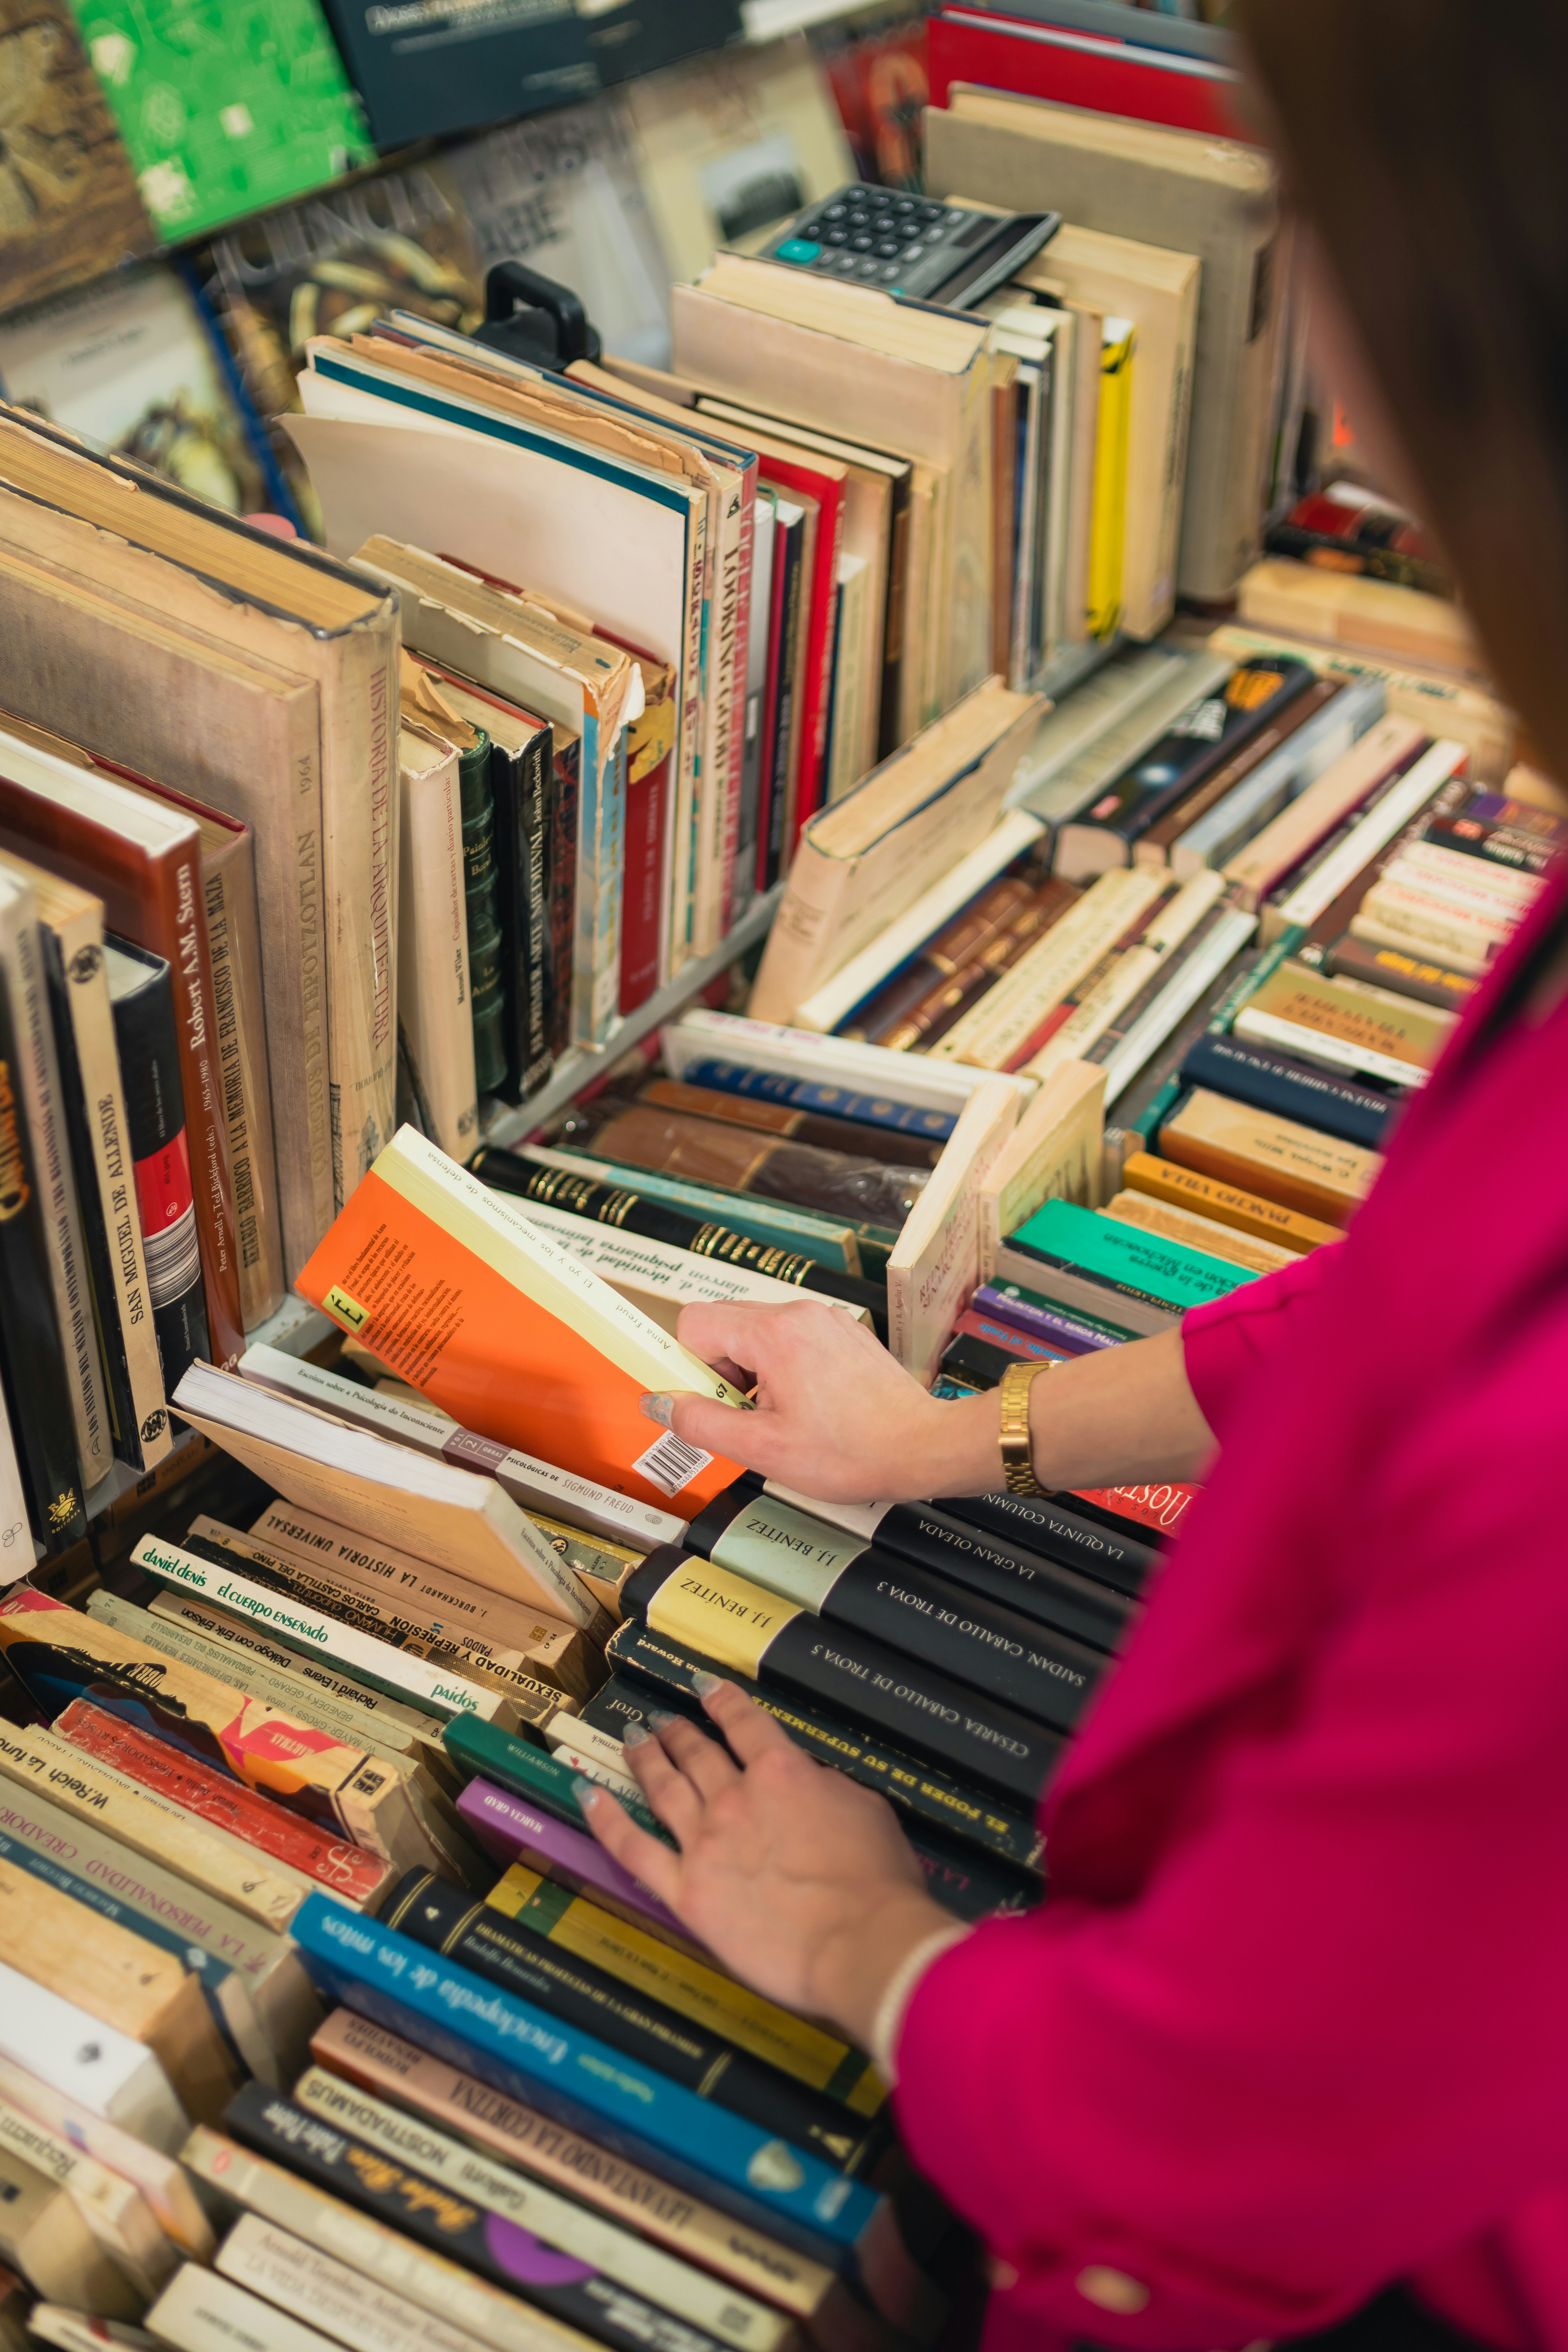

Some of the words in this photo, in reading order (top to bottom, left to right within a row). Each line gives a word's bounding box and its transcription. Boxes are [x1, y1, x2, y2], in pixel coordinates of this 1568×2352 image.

[367, 666, 388, 784] HISTORIA
[297, 754, 313, 794] 1964
[371, 784, 387, 821] DE
[443, 777, 454, 821] particular
[372, 821, 388, 858] LA
[445, 823, 454, 851] diario
[449, 859, 457, 888] cartas
[529, 825, 543, 919] MEDIEVAL
[171, 863, 195, 922] Stern
[203, 872, 225, 913] MAZA
[450, 888, 457, 897] de
[207, 917, 227, 936] LA
[296, 828, 324, 1012] TEPOTZOTLAN
[450, 900, 461, 940] Copiador
[178, 923, 199, 974] A.M.
[210, 938, 230, 961] DE
[370, 859, 390, 1050] ARQUITECTURA
[454, 948, 462, 969] Vilar
[183, 979, 208, 1049] Robert
[212, 964, 238, 1037] FRANCISCO
[220, 1039, 240, 1060] DE
[303, 1021, 323, 1058] DE
[222, 1061, 246, 1120] MEMORIA
[95, 1092, 125, 1179] ALLENDE
[228, 1121, 248, 1141] LA
[230, 1140, 249, 1151] A
[425, 1151, 462, 1183] defensa
[231, 1157, 255, 1210] BARROCO
[464, 1182, 478, 1196] de
[110, 1184, 129, 1214] DE
[480, 1195, 536, 1242] mecanismos
[114, 1214, 140, 1286] MIGUEL
[356, 1238, 377, 1263] fundamental
[376, 1223, 387, 1235] Anna
[538, 1242, 554, 1257] los
[598, 1233, 684, 1280] psiquiatría
[1102, 1229, 1181, 1272] Michoacán
[390, 1270, 401, 1284] placer
[400, 1251, 416, 1269] evitación
[557, 1255, 566, 1265] y
[567, 1264, 581, 1277] yo
[596, 1249, 671, 1288] identidad
[1128, 1249, 1179, 1280] guerra
[373, 1268, 391, 1290] adolescente
[396, 1273, 412, 1292] ocasiones
[421, 1277, 445, 1307] racionalización,
[583, 1278, 593, 1288] El
[687, 1266, 749, 1300] alarcón
[125, 1287, 145, 1325] SAN
[429, 1316, 440, 1328] vuelta
[450, 1287, 463, 1302] mismo,
[895, 1288, 903, 1310] Aguilar
[66, 1308, 88, 1352] MÉXICO
[615, 1304, 642, 1328] Freud
[645, 1328, 671, 1351] Anna
[76, 1351, 90, 1375] DEL
[80, 1373, 96, 1414] INICIOS
[297, 1367, 326, 1385] Escritos
[326, 1379, 346, 1393] sobre
[350, 1390, 388, 1413] Psicologia
[388, 1405, 399, 1416] do
[398, 1410, 445, 1435] Inconsciente
[716, 1383, 728, 1398] 67
[86, 1414, 100, 1437] LOS
[464, 1438, 477, 1449] 2
[482, 1445, 503, 1459] OBRAS
[506, 1454, 549, 1478] PSICOLÓGICAS
[549, 1473, 559, 1482] DE
[561, 1477, 603, 1502] SIGMUND
[603, 1494, 635, 1515] FREUD
[48, 1488, 73, 1513] RBA
[52, 1509, 80, 1534] EDITORES
[266, 1513, 334, 1555] UNIVERSAL
[917, 1518, 972, 1552] OLEADA
[1047, 1517, 1105, 1552] QUINTA
[744, 1515, 814, 1560] BENÍTEZ
[251, 1550, 276, 1568] PINO
[337, 1543, 396, 1580] HISTORIA
[591, 1555, 602, 1570] ALEPH
[815, 1546, 839, 1568] J.J.
[973, 1544, 1015, 1572] GRAN
[1105, 1545, 1124, 1560] LA
[275, 1562, 296, 1577] DEL
[398, 1570, 418, 1589] LA
[1017, 1564, 1035, 1580] LA
[295, 1570, 342, 1600] CASTILLA
[419, 1582, 477, 1615] BURCKHARDT
[545, 1561, 569, 1587] Psicologia
[569, 1588, 594, 1617] Inconsciente
[678, 1576, 749, 1621] BENÍTEZ
[876, 1579, 888, 1592] 3
[887, 1583, 935, 1616] TROYA
[104, 1598, 116, 1608] 71
[341, 1592, 381, 1618] CARLOS
[478, 1607, 488, 1618] J.
[936, 1607, 958, 1626] DE
[150, 1620, 193, 1647] DESARROLLO
[179, 1606, 216, 1632] Erikson
[215, 1624, 236, 1641] Erik
[344, 1607, 398, 1642] HUMANO
[749, 1608, 773, 1630] J.J.
[142, 1634, 179, 1658] MENTALES
[192, 1641, 206, 1653] DEL
[235, 1634, 255, 1649] con
[388, 1614, 461, 1656] REPRESION
[460, 1634, 493, 1658] PAIDOS
[810, 1641, 823, 1656] 5
[958, 1617, 1025, 1659] CABALLO
[206, 1647, 256, 1677] PSICOANALISIS
[252, 1641, 292, 1670] Diálogo
[460, 1648, 472, 1661] Y
[637, 1635, 685, 1669] Howard
[823, 1647, 870, 1679] TROYA
[179, 1652, 233, 1684] ENFERMEDADES
[301, 1665, 333, 1689] Evans
[473, 1654, 563, 1704] SEXUALIDAD
[871, 1672, 893, 1691] DE
[1025, 1649, 1086, 1688] SAIDAN.
[233, 1679, 249, 1692] LAS
[267, 1676, 305, 1700] GERARD
[305, 1692, 313, 1701] y
[337, 1683, 378, 1711] Richard
[264, 1694, 287, 1710] otros
[288, 1703, 295, 1713] y
[310, 1696, 354, 1723] BENEDEK
[605, 1694, 644, 1728] Grof
[893, 1681, 962, 1726] CABALLO
[748, 1693, 862, 1759] SUPERMENTE
[108, 1734, 175, 1779] PENSADORES
[508, 1740, 560, 1779] WILLIAMSON
[862, 1752, 889, 1773] SU
[890, 1766, 917, 1787] DE
[484, 1794, 510, 1814] GRAD
[918, 1780, 982, 1821] PODER
[509, 1808, 544, 1833] MARCIA
[982, 1813, 1009, 1834] EL
[83, 1853, 212, 1941] PERSONALIDAD
[217, 1933, 245, 1958] LA
[315, 1912, 376, 1959] mitos
[303, 2073, 449, 2171] NOSTRADAMUS
